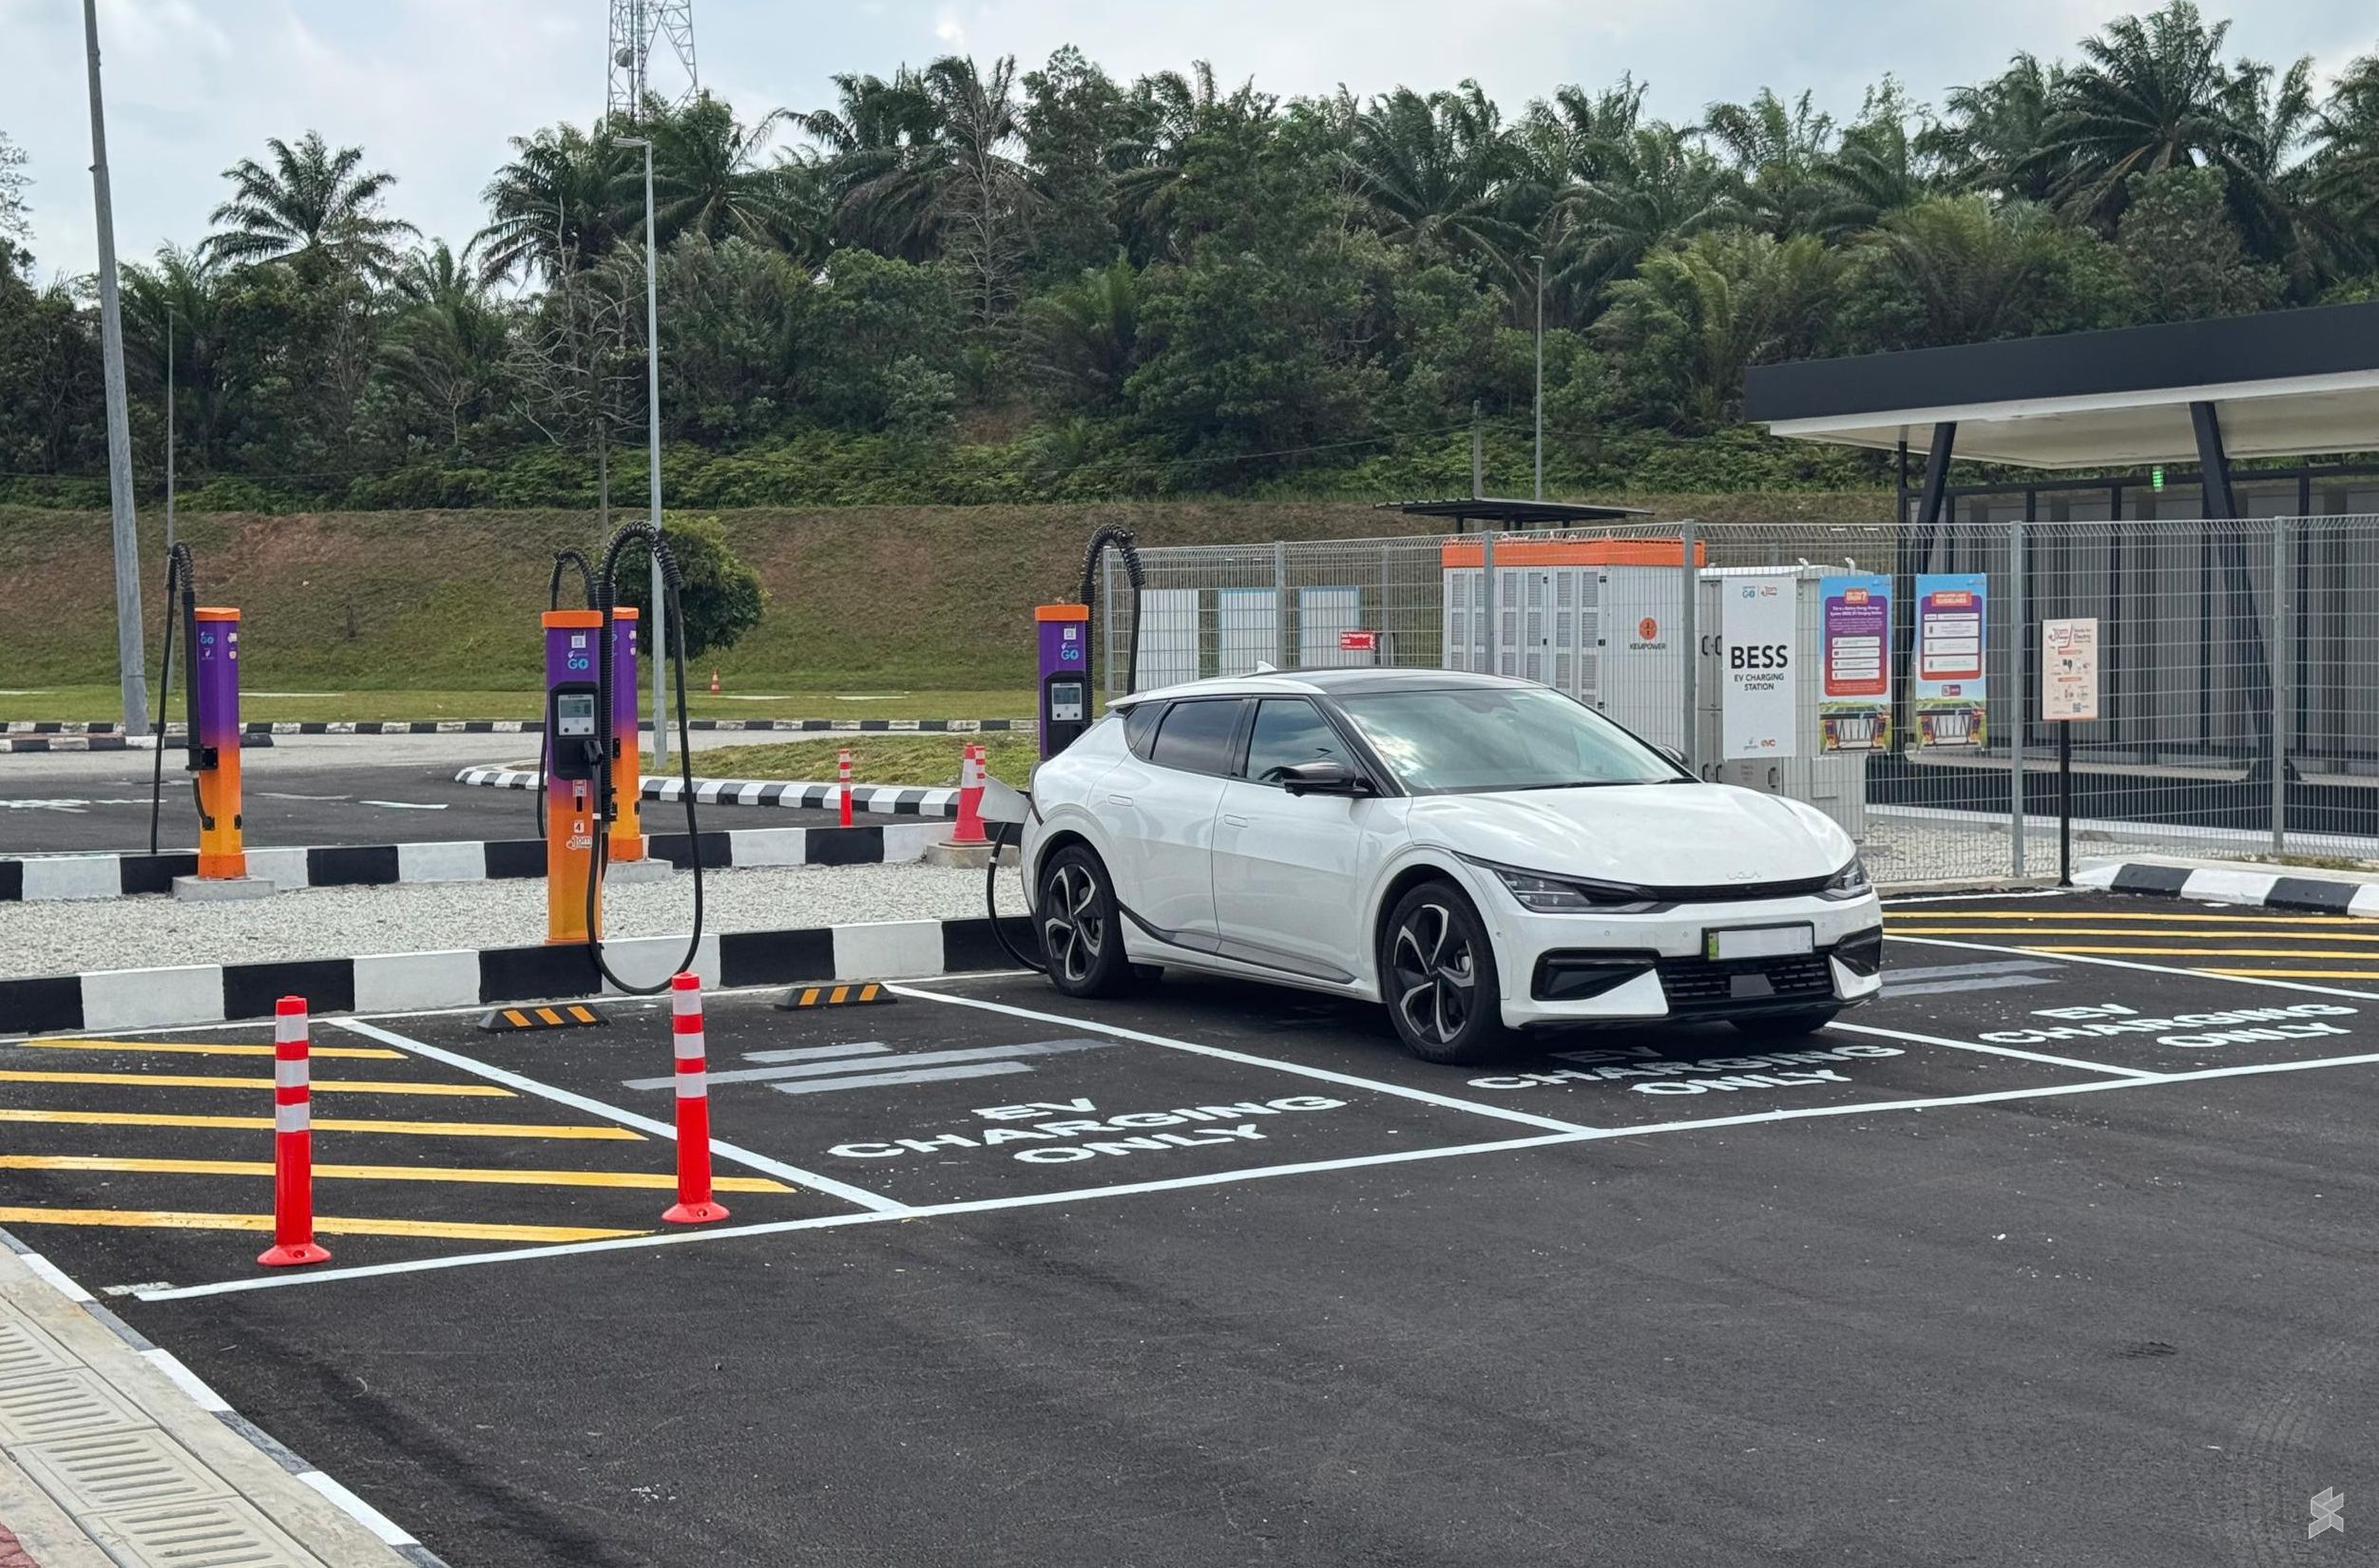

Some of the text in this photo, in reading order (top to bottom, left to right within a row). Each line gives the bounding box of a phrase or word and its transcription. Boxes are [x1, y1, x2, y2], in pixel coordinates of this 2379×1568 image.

[567, 658, 589, 670] GO
[1061, 650, 1079, 660] GO
[1731, 644, 1788, 669] BESS
[1734, 673, 1785, 682] EV CHARGING
[1744, 682, 1775, 691] STATION
[575, 823, 582, 832] 4
[1978, 1004, 2359, 1043] CHARGING
[2029, 1004, 2139, 1020] EV
[2156, 1022, 2352, 1048] ONLY
[1467, 1045, 1907, 1089] CHARGING
[1628, 1069, 1853, 1095] ONLY
[970, 1098, 1097, 1120] EV
[827, 1096, 1348, 1158] CHARGING
[1013, 1123, 1268, 1163] ONLY
